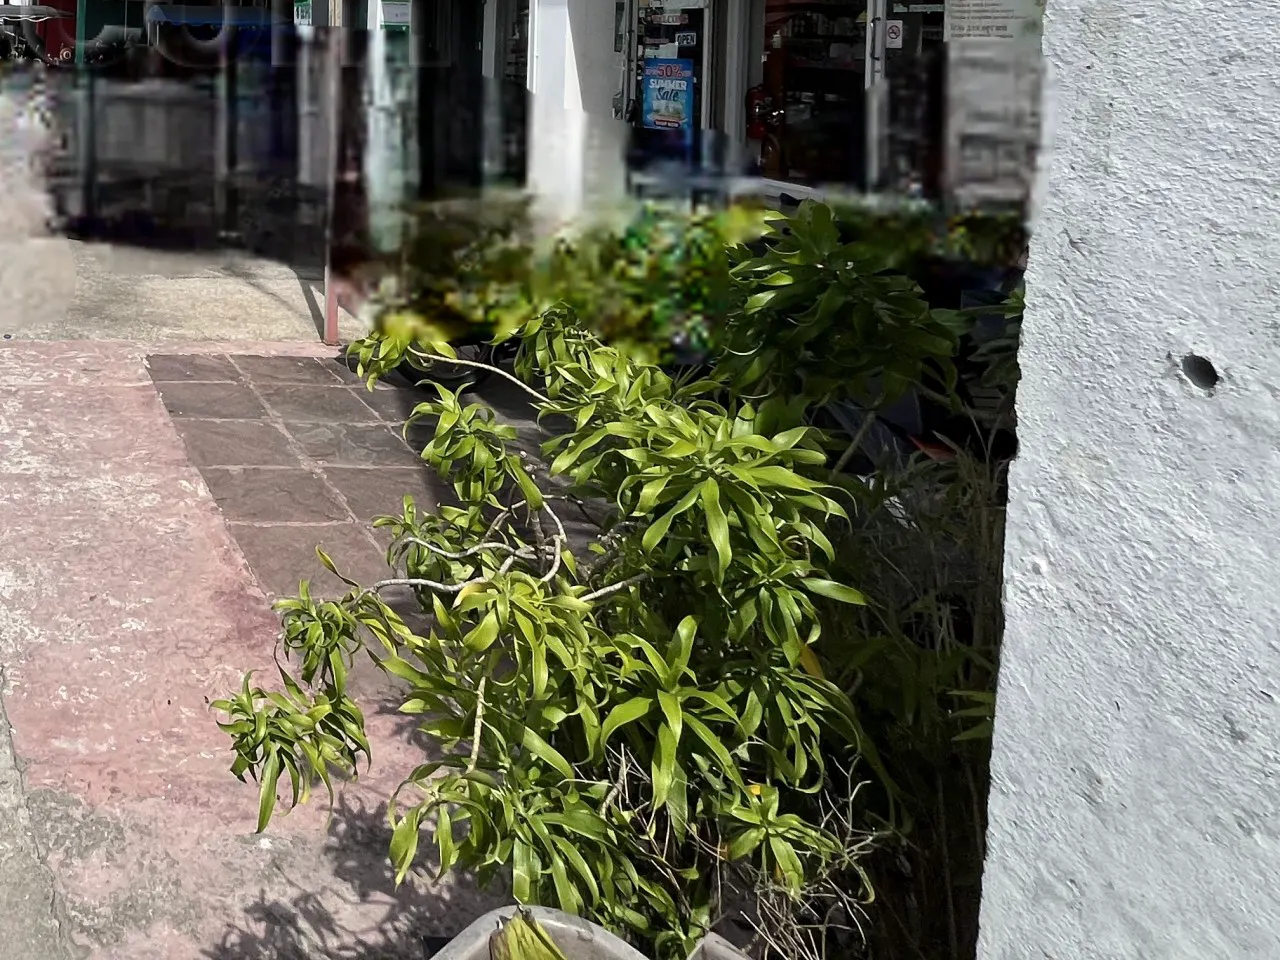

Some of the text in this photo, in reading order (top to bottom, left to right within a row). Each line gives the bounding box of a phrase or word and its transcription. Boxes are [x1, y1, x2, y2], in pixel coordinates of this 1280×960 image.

[677, 34, 696, 46] OPEN
[657, 63, 683, 79] 50%
[648, 78, 687, 91] SUMMER
[656, 86, 680, 102] Sale
